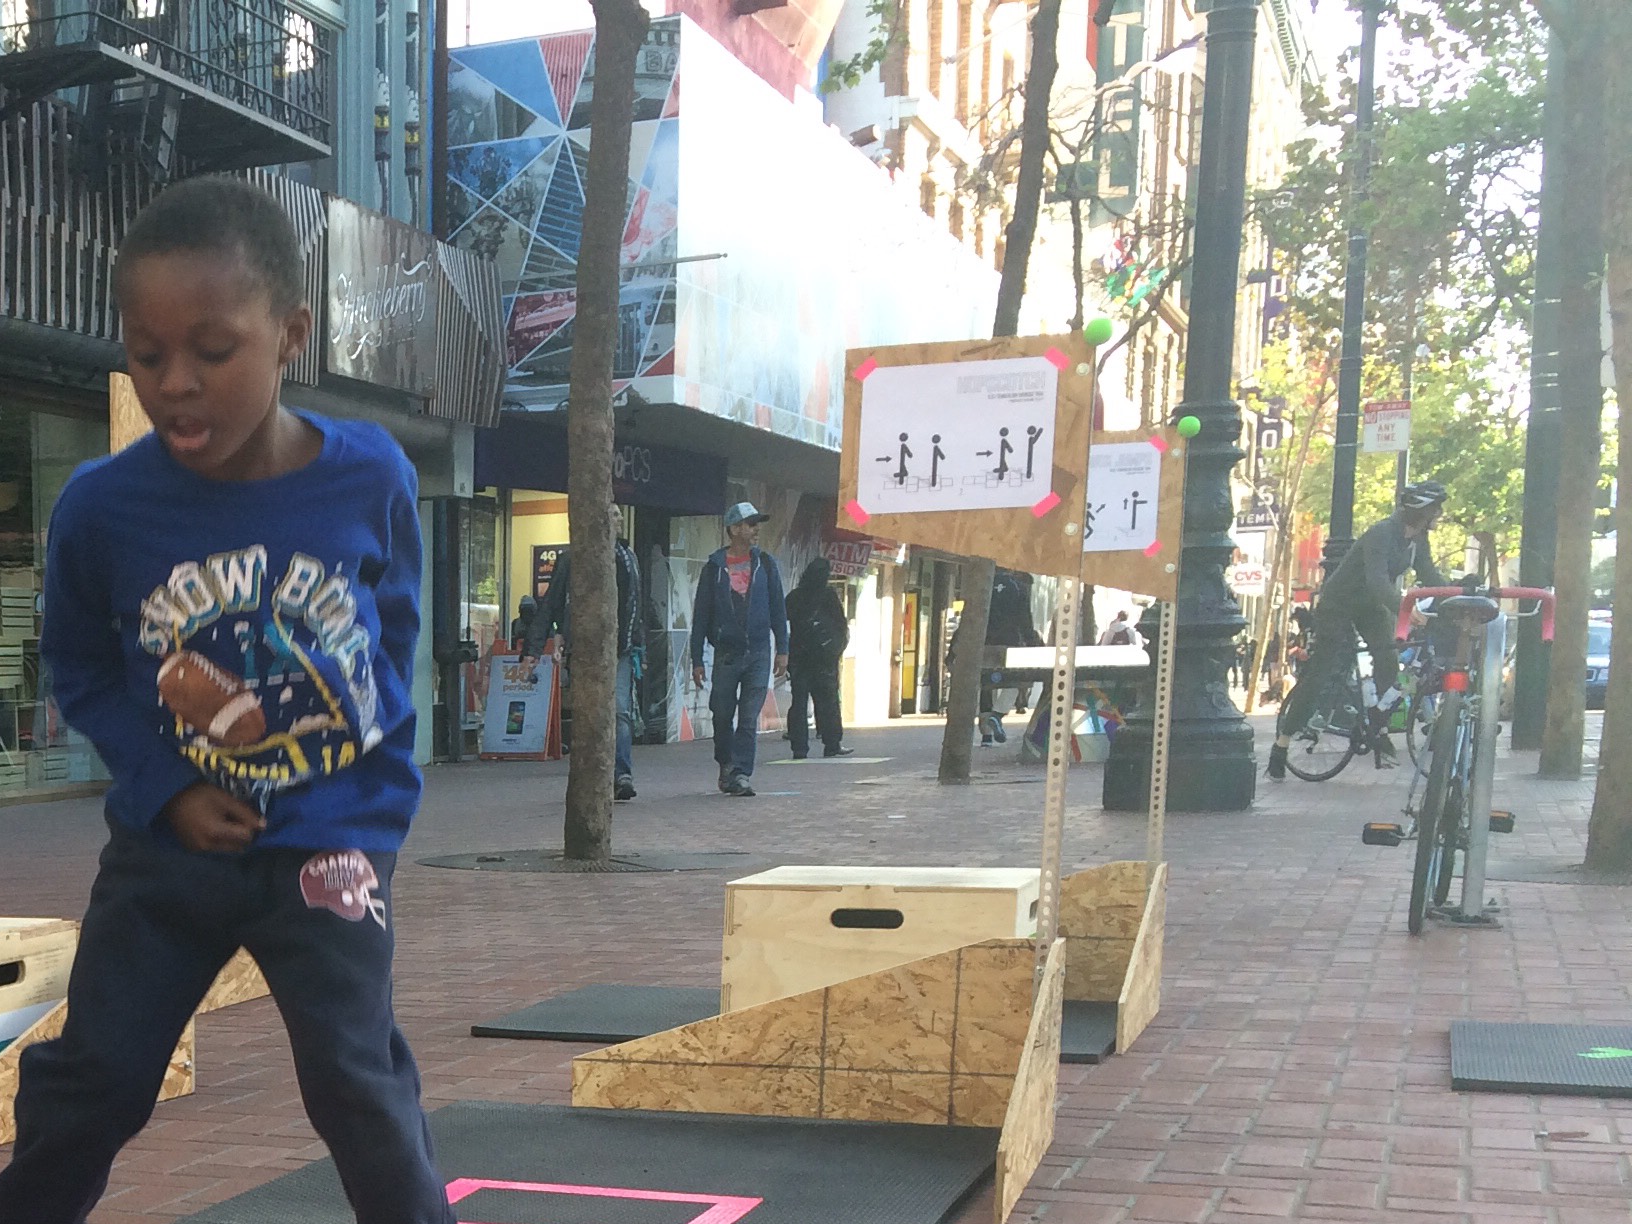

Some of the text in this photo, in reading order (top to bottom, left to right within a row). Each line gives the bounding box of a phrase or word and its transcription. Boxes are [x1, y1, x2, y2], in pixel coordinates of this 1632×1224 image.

[828, 541, 868, 566] ATM
[830, 562, 865, 577] SID
[1235, 570, 1263, 581] CVS
